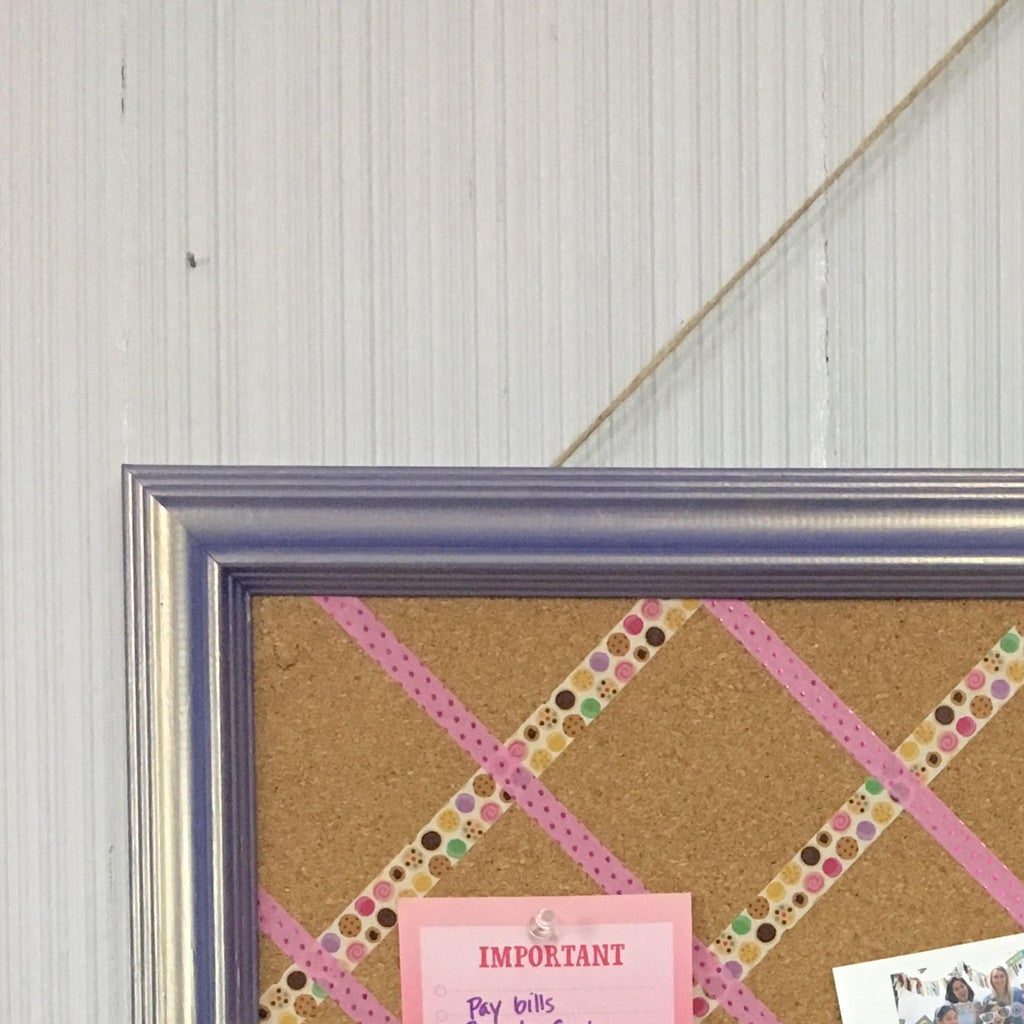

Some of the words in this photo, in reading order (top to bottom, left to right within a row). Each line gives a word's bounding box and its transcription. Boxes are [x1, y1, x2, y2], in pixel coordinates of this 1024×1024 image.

[479, 943, 625, 968] IMPORTANT
[466, 996, 501, 1024] Pay
[514, 992, 555, 1014] bills
